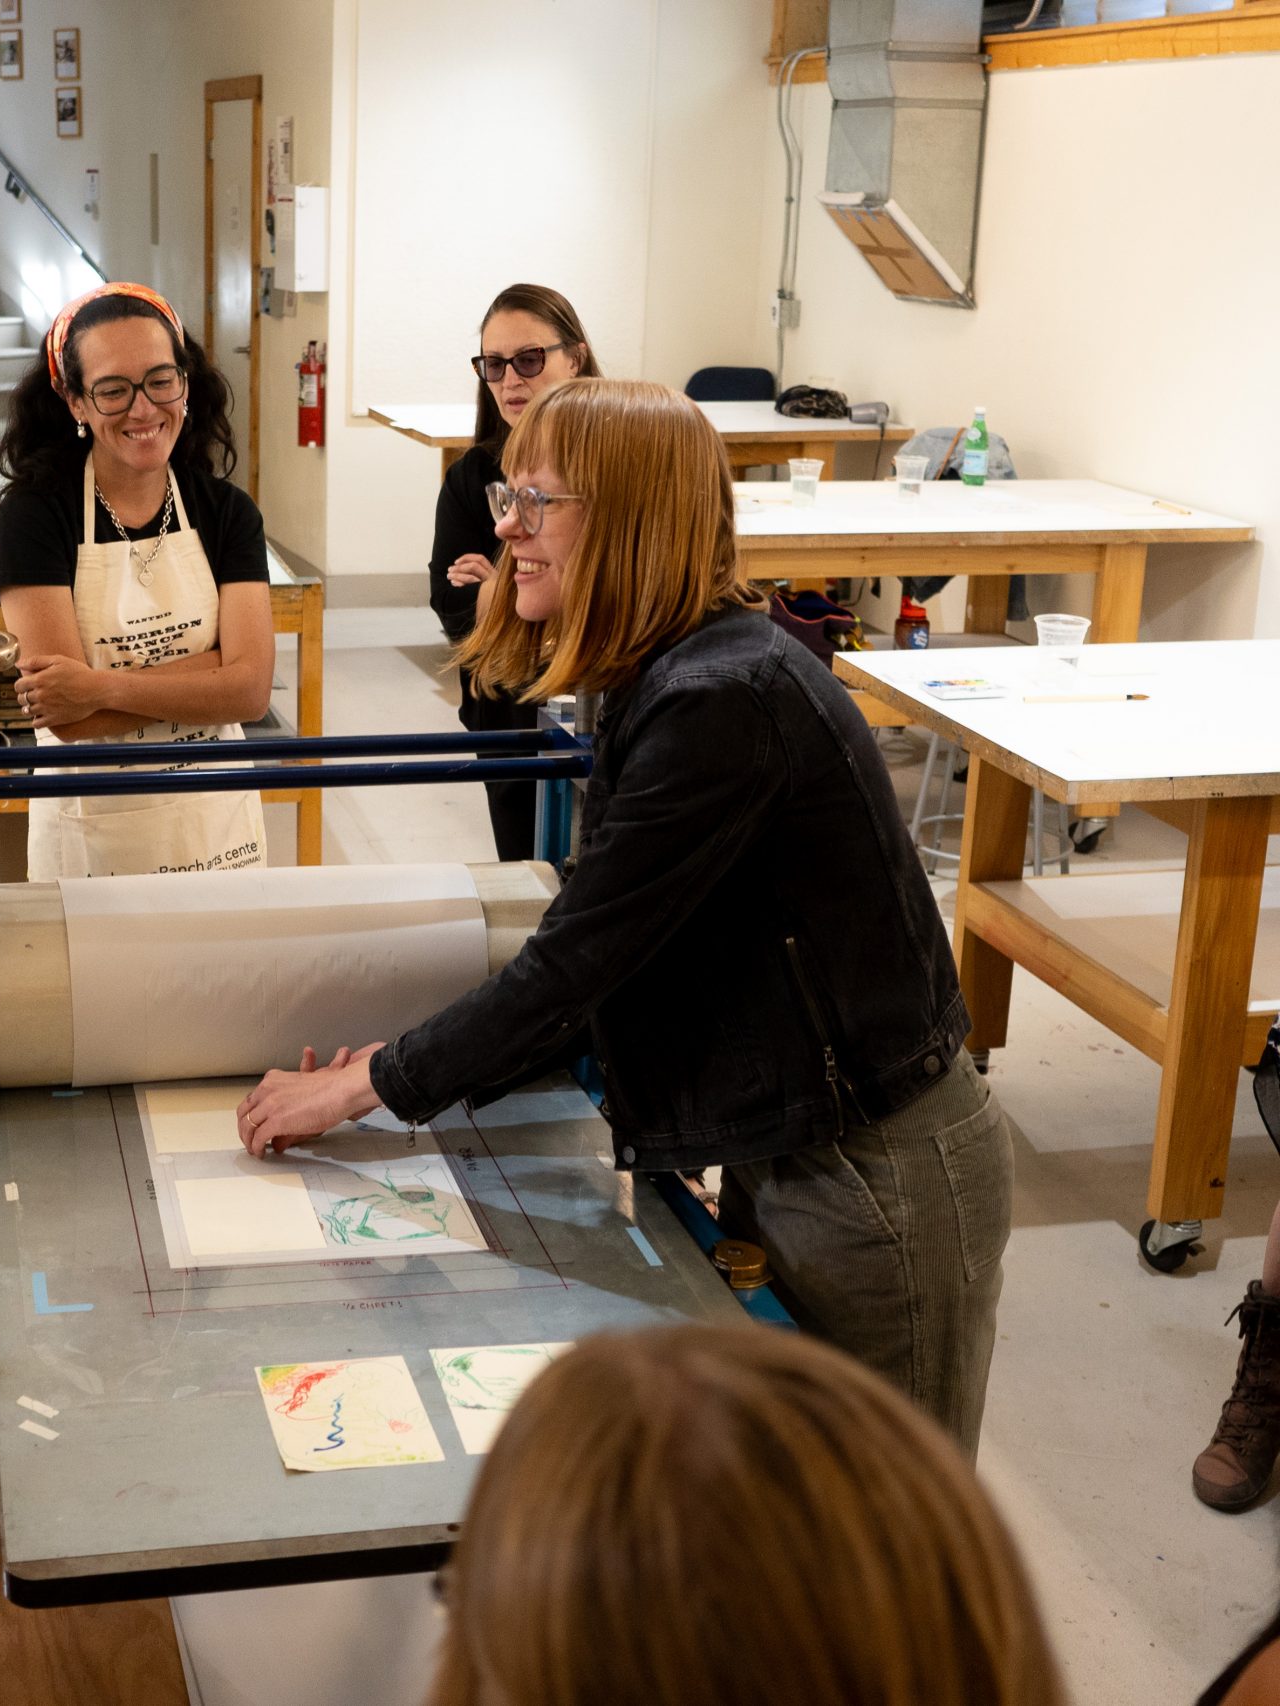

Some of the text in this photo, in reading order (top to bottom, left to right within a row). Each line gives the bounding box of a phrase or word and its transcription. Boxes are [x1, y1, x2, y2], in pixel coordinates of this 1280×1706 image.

[126, 611, 172, 625] WANTED
[94, 618, 202, 645] ANDERSON
[116, 631, 185, 652] RANCH
[207, 853, 222, 871] arts
[224, 841, 259, 862] cente
